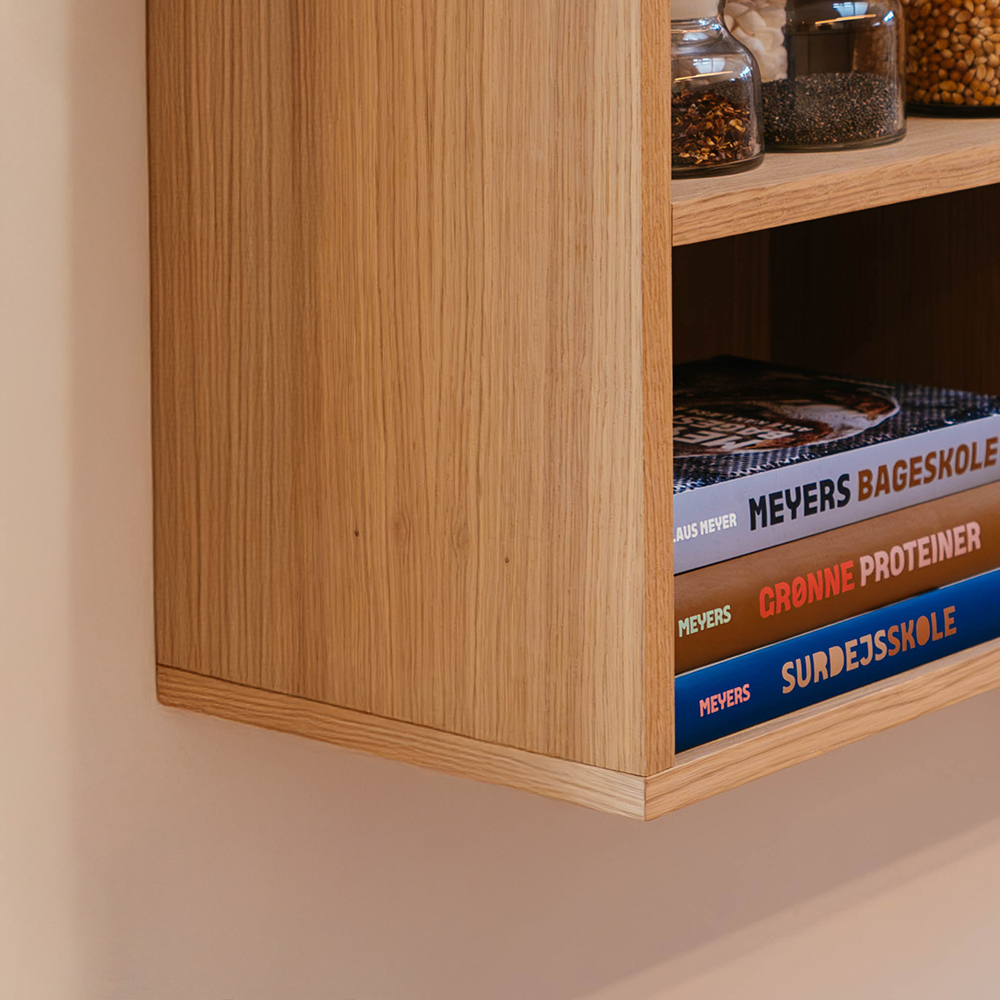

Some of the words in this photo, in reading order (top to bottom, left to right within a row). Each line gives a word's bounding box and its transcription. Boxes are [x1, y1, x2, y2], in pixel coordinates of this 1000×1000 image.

[748, 473, 851, 531] MEYERS
[857, 436, 999, 502] BAGESKOLE
[673, 522, 699, 543] AUS
[699, 512, 738, 536] MEYER
[759, 560, 855, 619] GRØNNE
[859, 521, 981, 587] PROTEINER
[678, 605, 732, 637] MEYERS
[781, 606, 957, 695] SURDEJSSKOLE
[699, 683, 751, 717] MEYERS
